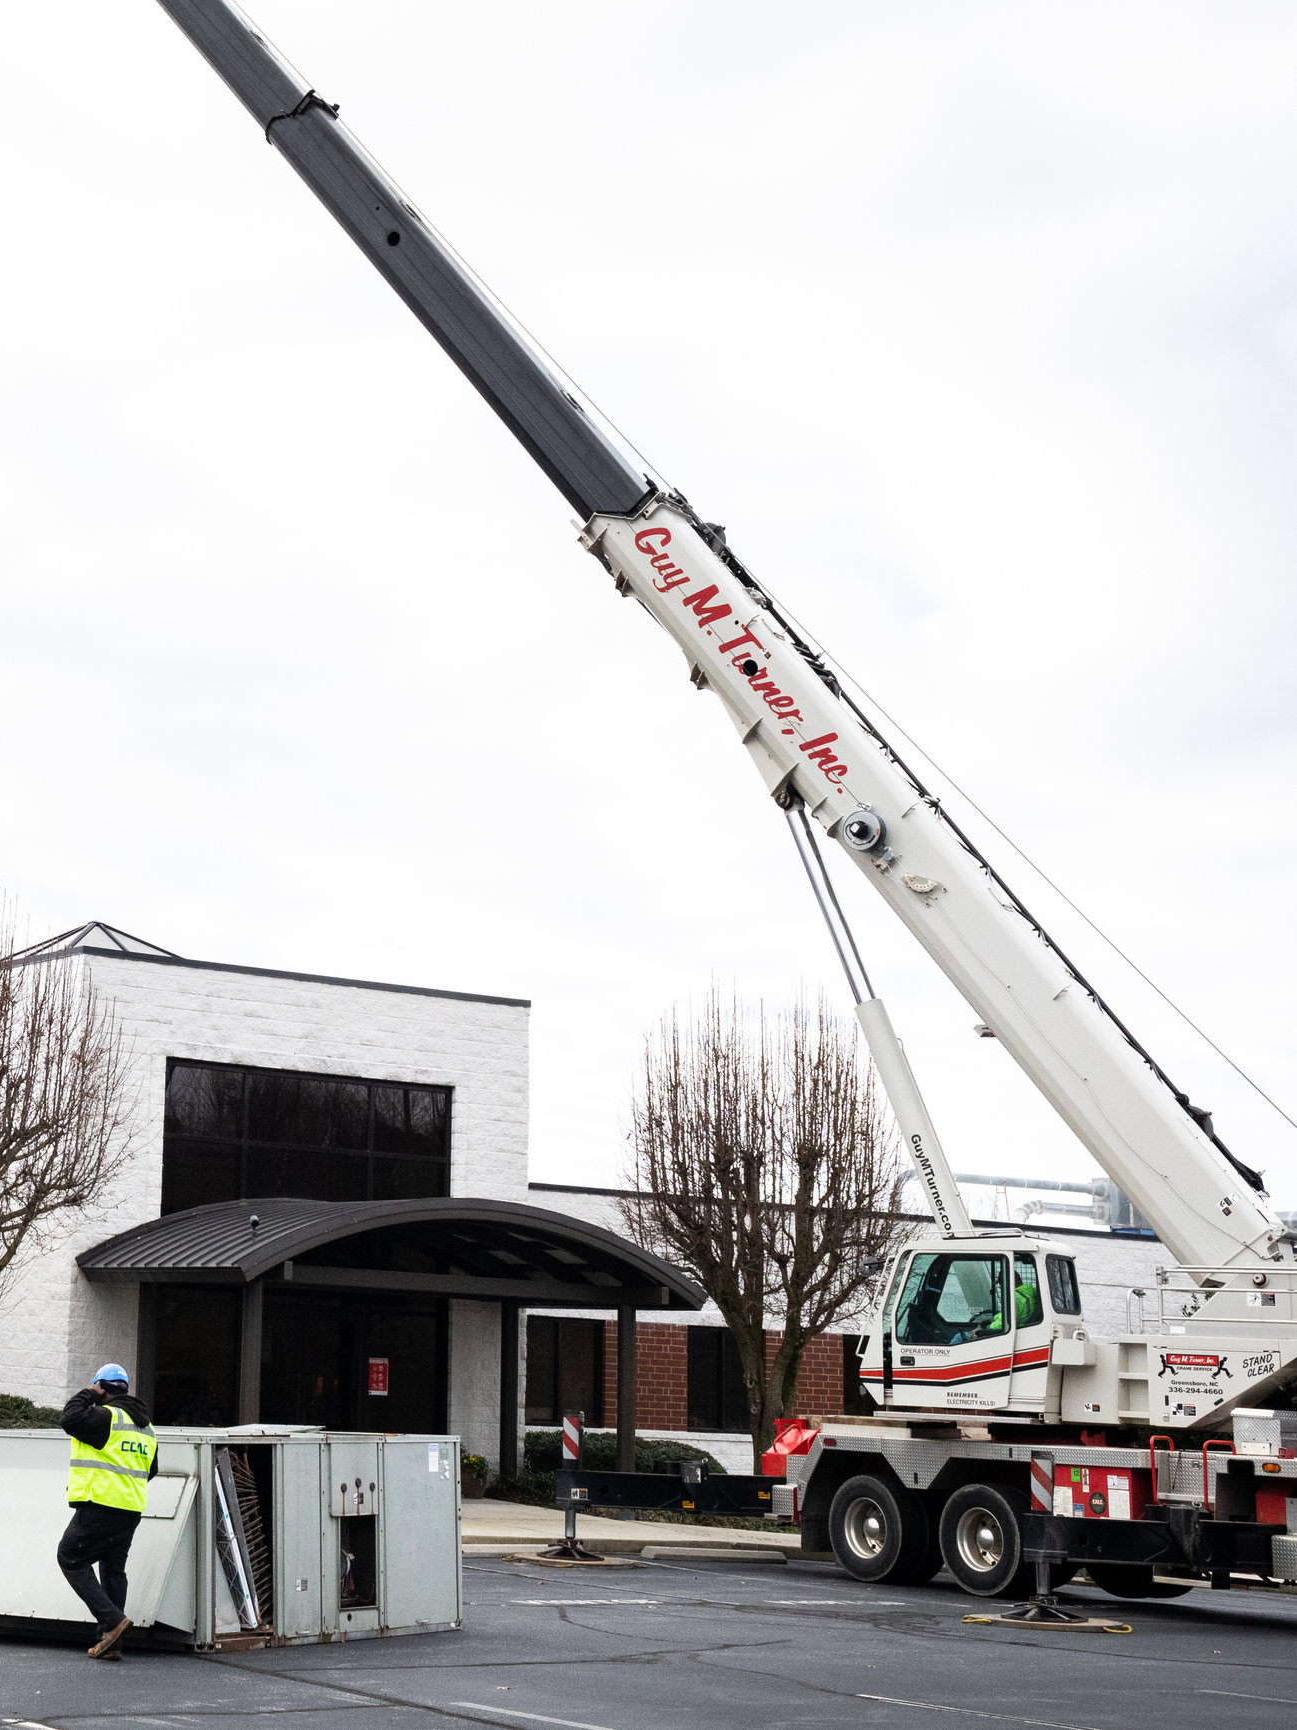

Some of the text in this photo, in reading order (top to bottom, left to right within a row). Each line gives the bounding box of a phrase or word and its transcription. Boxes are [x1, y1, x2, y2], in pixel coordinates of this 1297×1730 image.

[635, 527, 691, 593] Guy
[682, 584, 733, 636] M.
[798, 732, 848, 794] Inc.
[1169, 1355, 1181, 1363] Guy
[1242, 1353, 1273, 1369] STAND
[1247, 1363, 1275, 1378] CLEAR
[1168, 1387, 1223, 1395] 336-294-4660
[121, 1440, 149, 1455] CCAC
